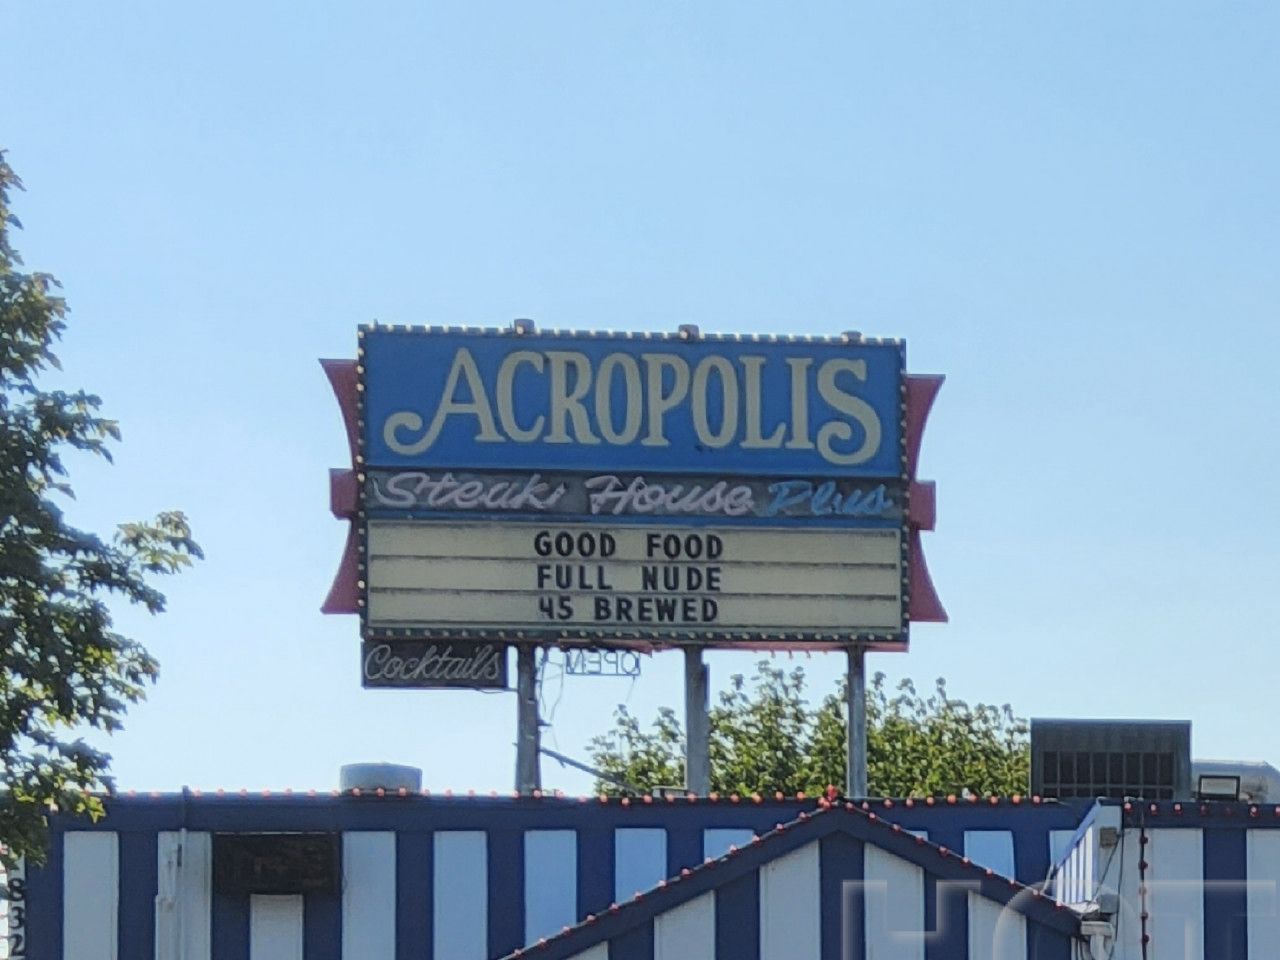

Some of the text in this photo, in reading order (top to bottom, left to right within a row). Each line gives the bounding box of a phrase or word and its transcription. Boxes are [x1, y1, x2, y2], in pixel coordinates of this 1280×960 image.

[383, 346, 882, 465] ACROPOLIS
[372, 472, 894, 517] Steak House Plus
[533, 530, 723, 560] GOOD FOOD
[537, 564, 721, 592] FULL NUDE
[538, 596, 718, 623] 45 BREWED
[364, 644, 502, 680] Cocktails
